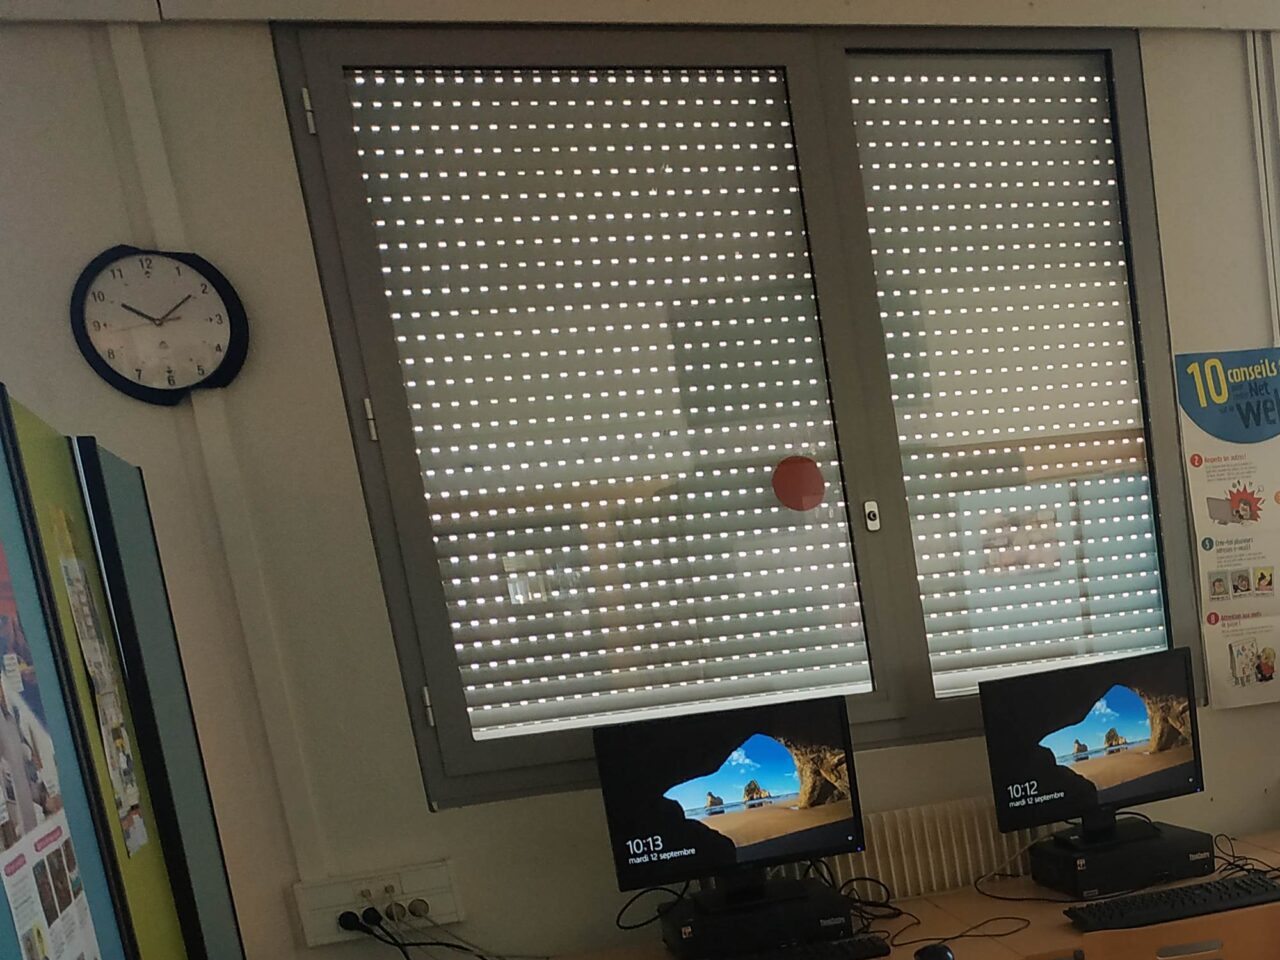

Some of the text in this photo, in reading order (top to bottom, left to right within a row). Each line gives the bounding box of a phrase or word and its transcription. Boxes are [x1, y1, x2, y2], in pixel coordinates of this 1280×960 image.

[139, 258, 153, 270] 12
[110, 268, 124, 279] 11
[175, 266, 181, 277] 1
[200, 283, 208, 295] 2
[91, 291, 105, 303] 10
[215, 313, 223, 325] 3
[93, 320, 101, 332] 9
[215, 343, 222, 353] 4
[107, 349, 115, 360] 8
[135, 368, 142, 380] 7
[197, 365, 205, 376] 5
[167, 375, 176, 386] 6
[1186, 357, 1229, 408] 10
[1227, 358, 1278, 383] conseils
[1007, 780, 1038, 799] 10:12
[626, 835, 663, 855] 10:13
[628, 847, 696, 865] mardi 12 septembre
